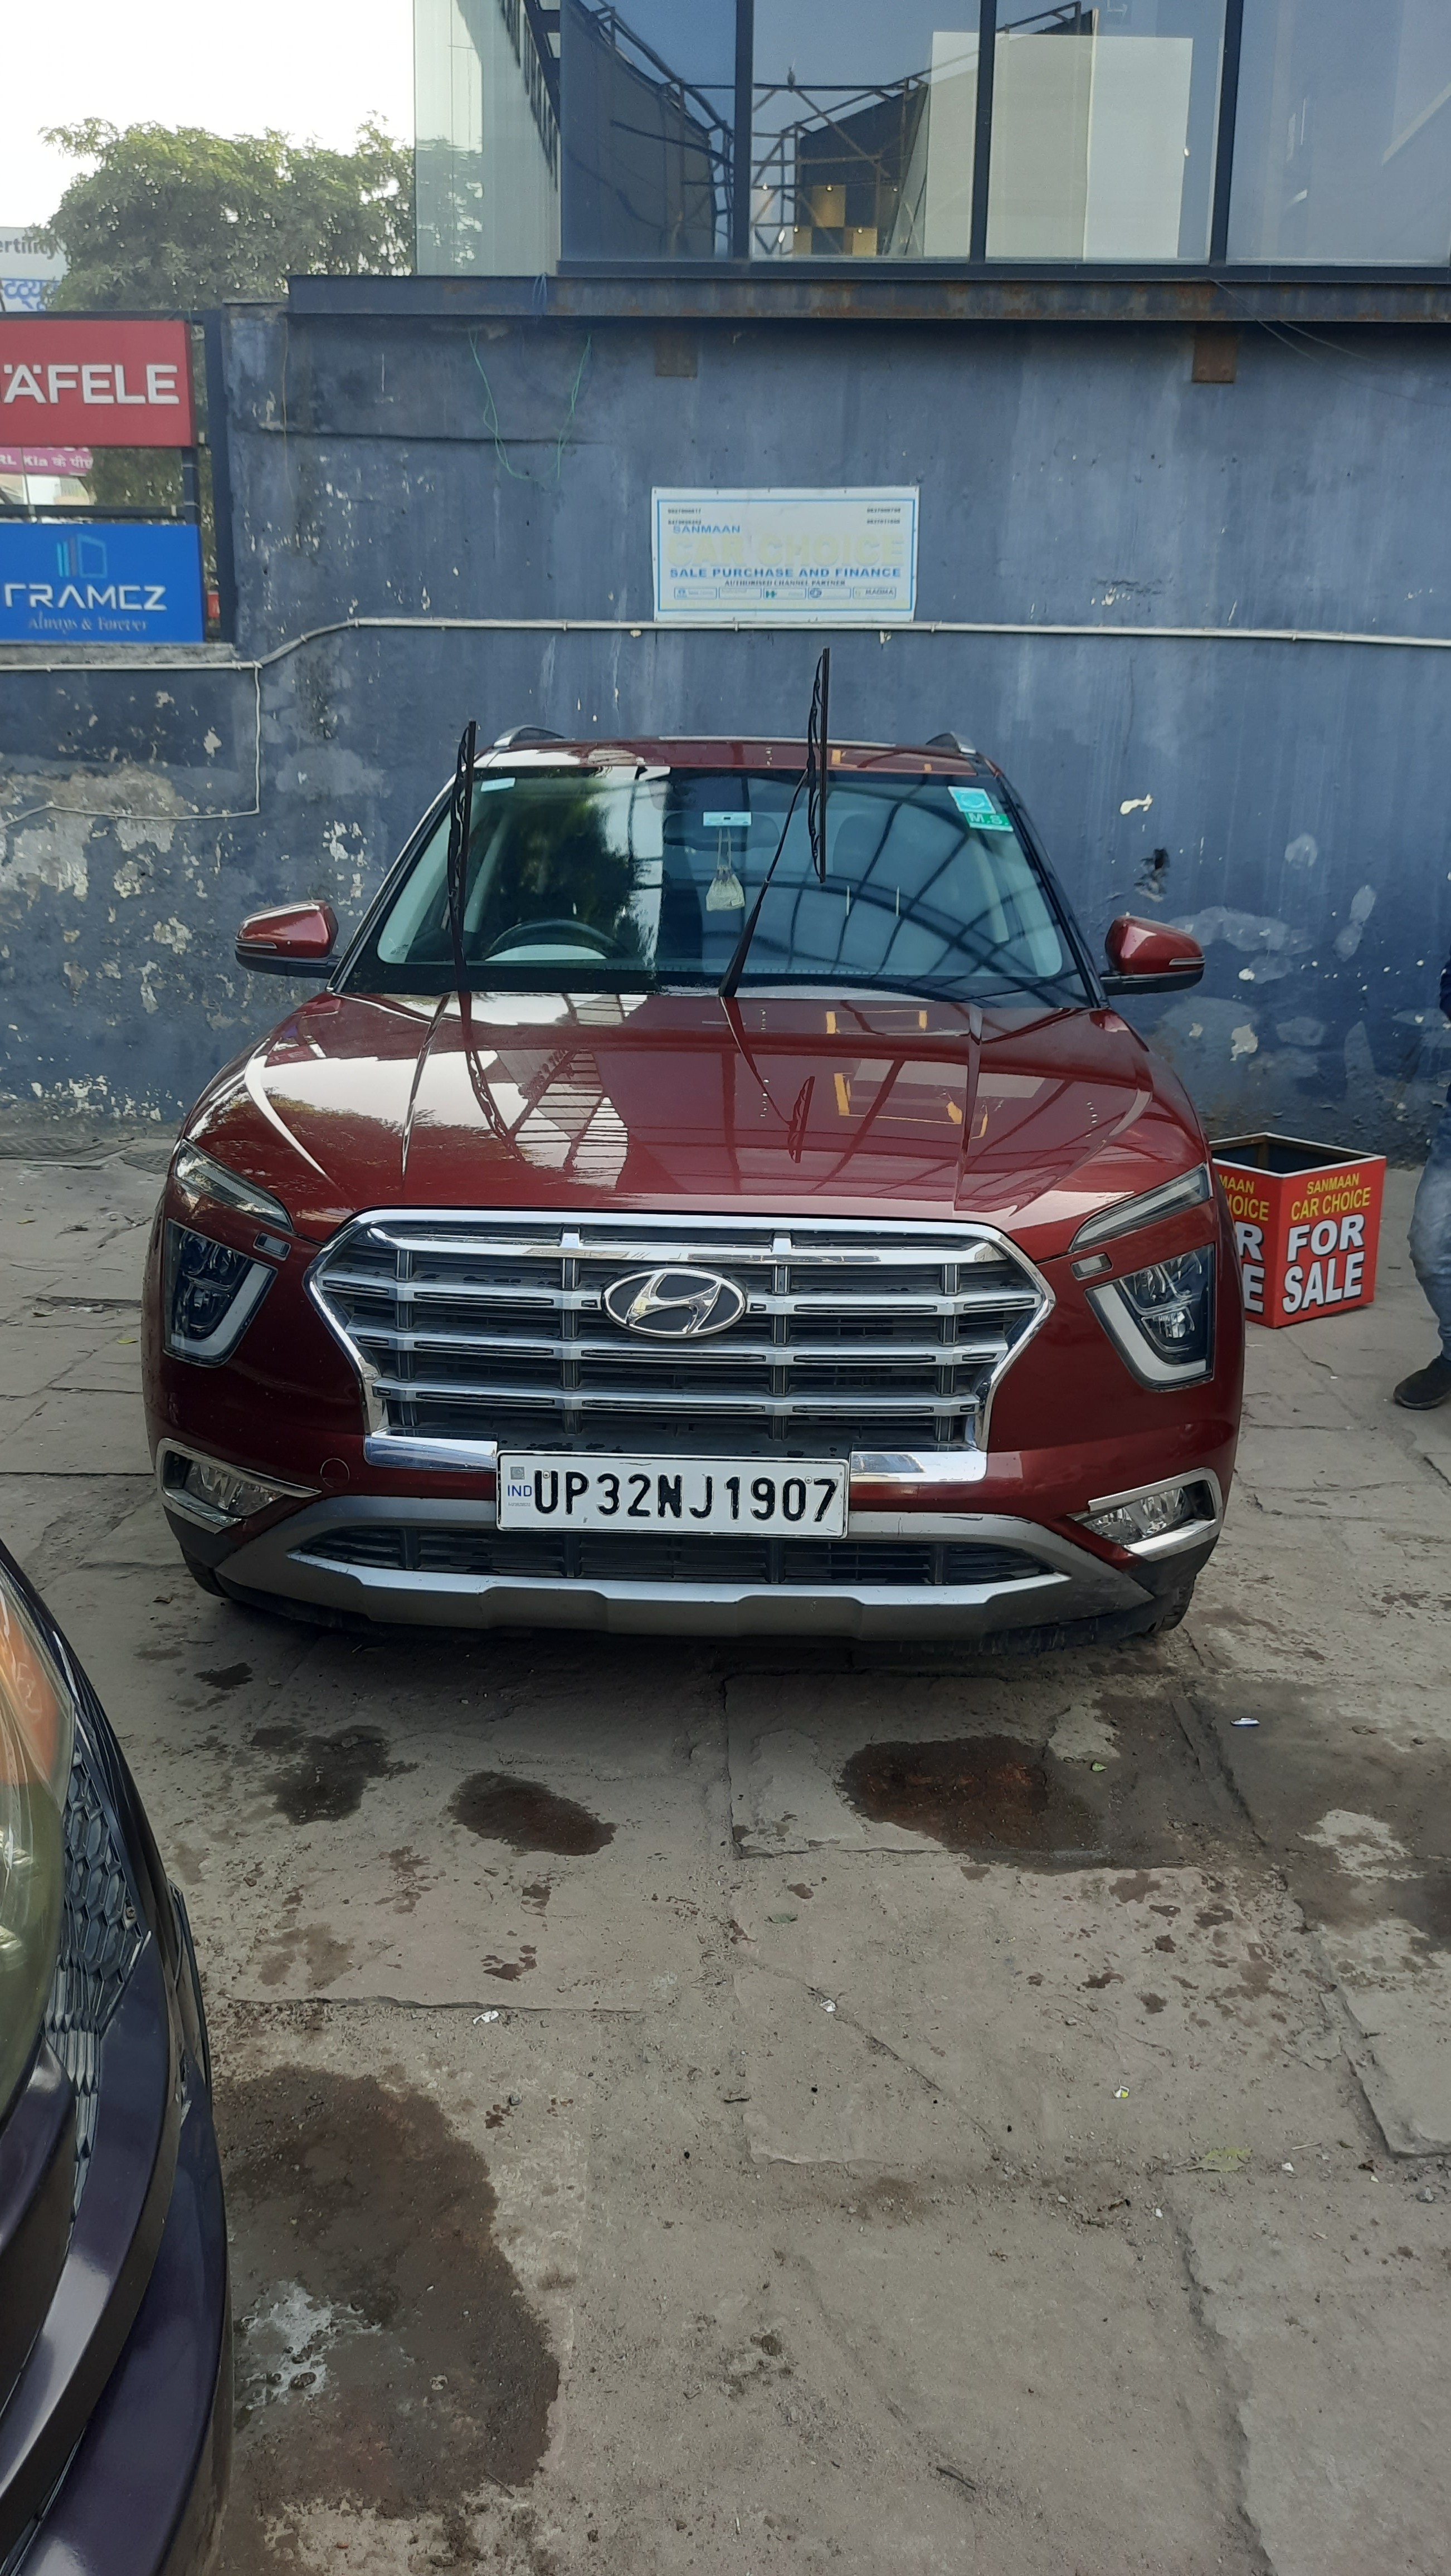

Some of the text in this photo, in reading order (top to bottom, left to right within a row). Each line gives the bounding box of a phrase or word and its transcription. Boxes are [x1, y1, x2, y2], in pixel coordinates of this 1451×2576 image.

[673, 525, 741, 534] SANMAAN
[667, 533, 904, 567] CAR CHOICE
[670, 567, 901, 578] SALE PURCHASE AND FINANCE
[81, 618, 92, 631] &
[1307, 1173, 1360, 1195] SANMAAN
[1291, 1187, 1371, 1221] CAR CHOICE
[1287, 1214, 1365, 1262] FOR
[1282, 1251, 1365, 1314] SALE
[508, 1470, 839, 1523] IND UP32NJ1907
